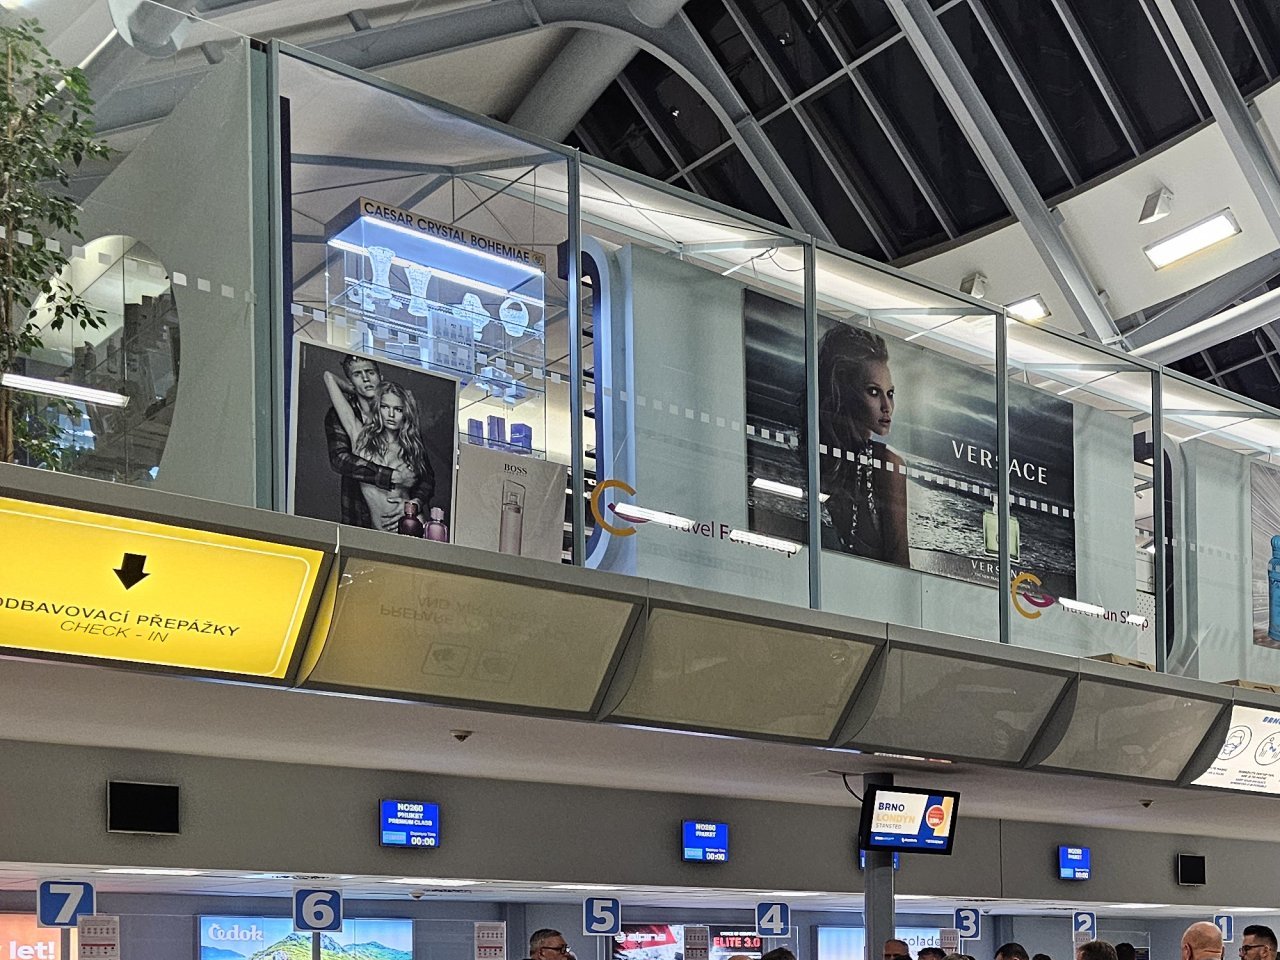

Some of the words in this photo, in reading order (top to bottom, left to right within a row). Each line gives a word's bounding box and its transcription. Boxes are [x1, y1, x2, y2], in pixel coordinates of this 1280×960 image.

[364, 202, 413, 227] CAESAR
[417, 218, 467, 244] CRYSTAL
[471, 235, 530, 263] BOHEMIAE
[504, 463, 527, 474] BOSS
[952, 440, 1047, 485] VERACE
[60, 620, 131, 638] CHECK
[148, 631, 169, 643] IN
[137, 613, 240, 637] PŘEPÁŽKY
[1120, 610, 1149, 631] Sp
[878, 802, 905, 812] BRNO
[875, 822, 902, 830] STANSTED
[411, 837, 436, 846] 00:00
[706, 852, 725, 861] 00:00
[50, 884, 84, 923] 7
[302, 892, 335, 928] 6
[591, 900, 615, 932] 5
[759, 904, 784, 934] 4
[960, 910, 976, 937] 3
[1077, 913, 1092, 932] 2
[207, 923, 265, 941] Čedok
[1218, 917, 1228, 941] 1
[10, 941, 56, 960] let!
[713, 937, 741, 949] ELITE
[744, 937, 761, 948] 3.0
